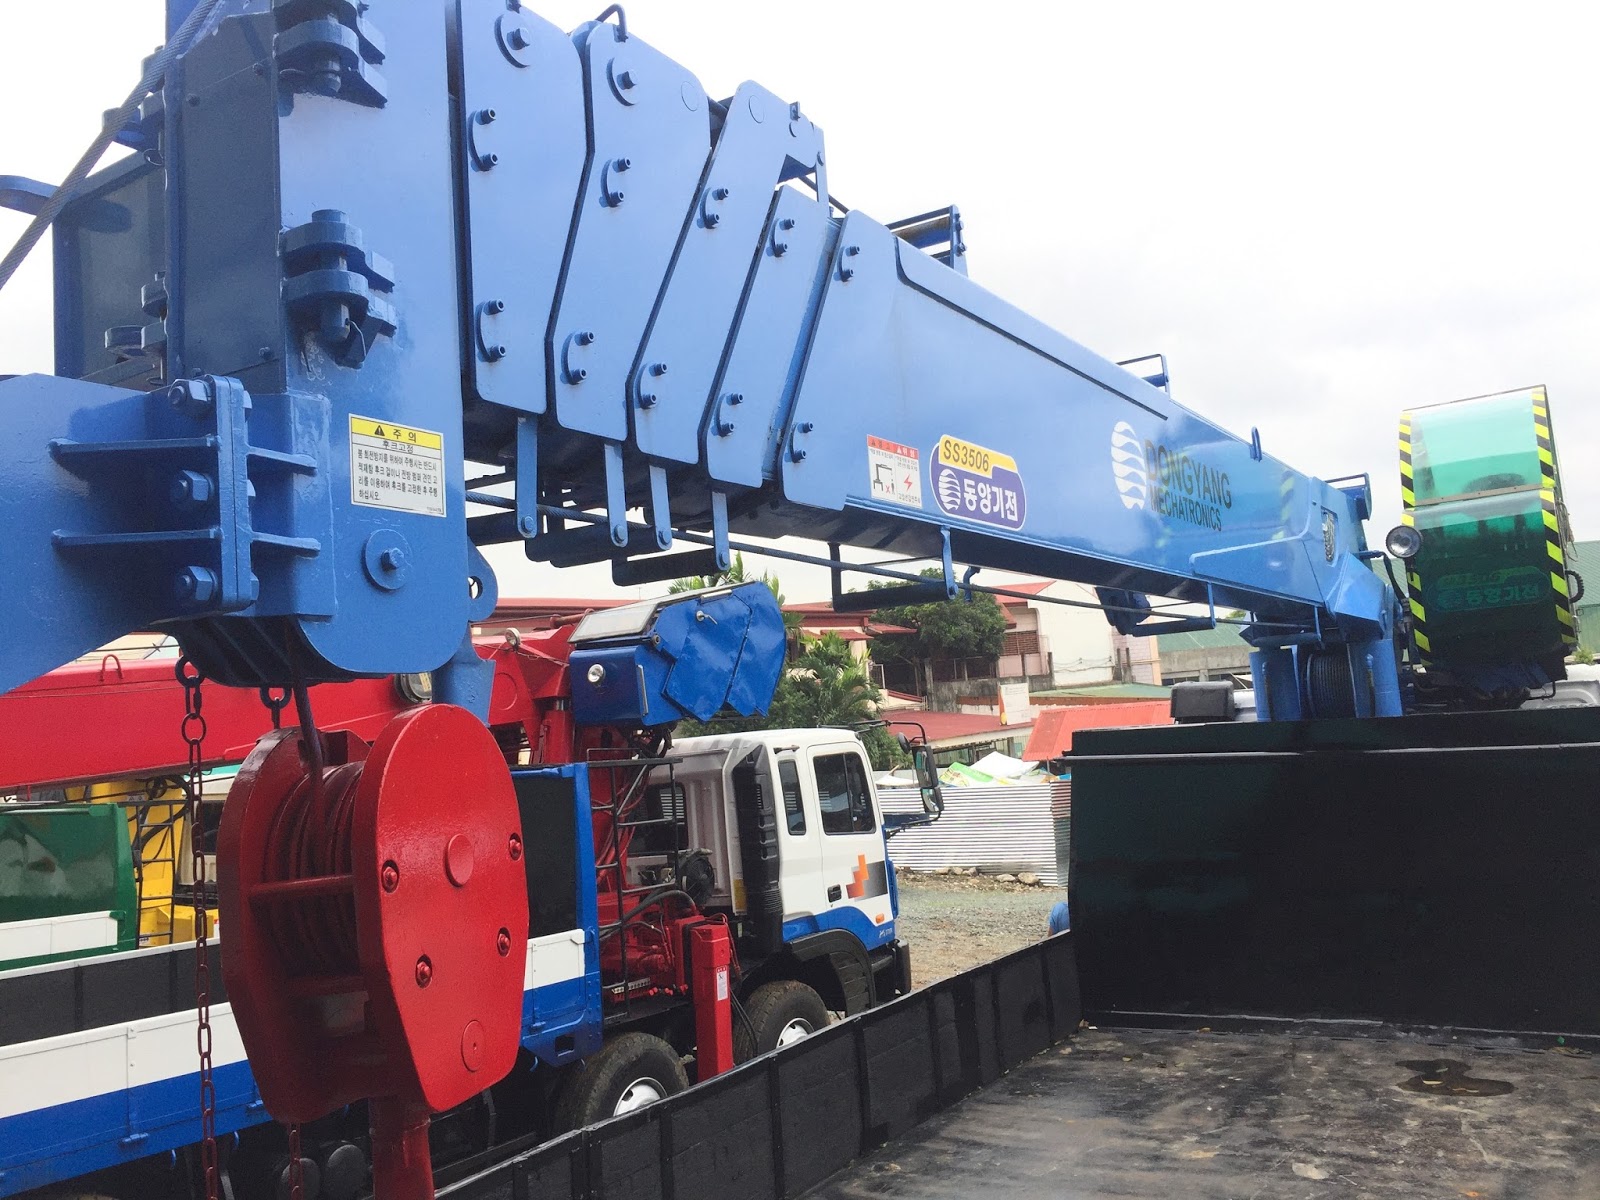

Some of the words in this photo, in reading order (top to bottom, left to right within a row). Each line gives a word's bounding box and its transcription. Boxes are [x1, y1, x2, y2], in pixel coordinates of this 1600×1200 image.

[943, 439, 990, 472] SS3506
[1144, 439, 1232, 509] DONGYANG
[963, 477, 1019, 522] 동양기전
[1150, 484, 1222, 532] MECHATRONICS
